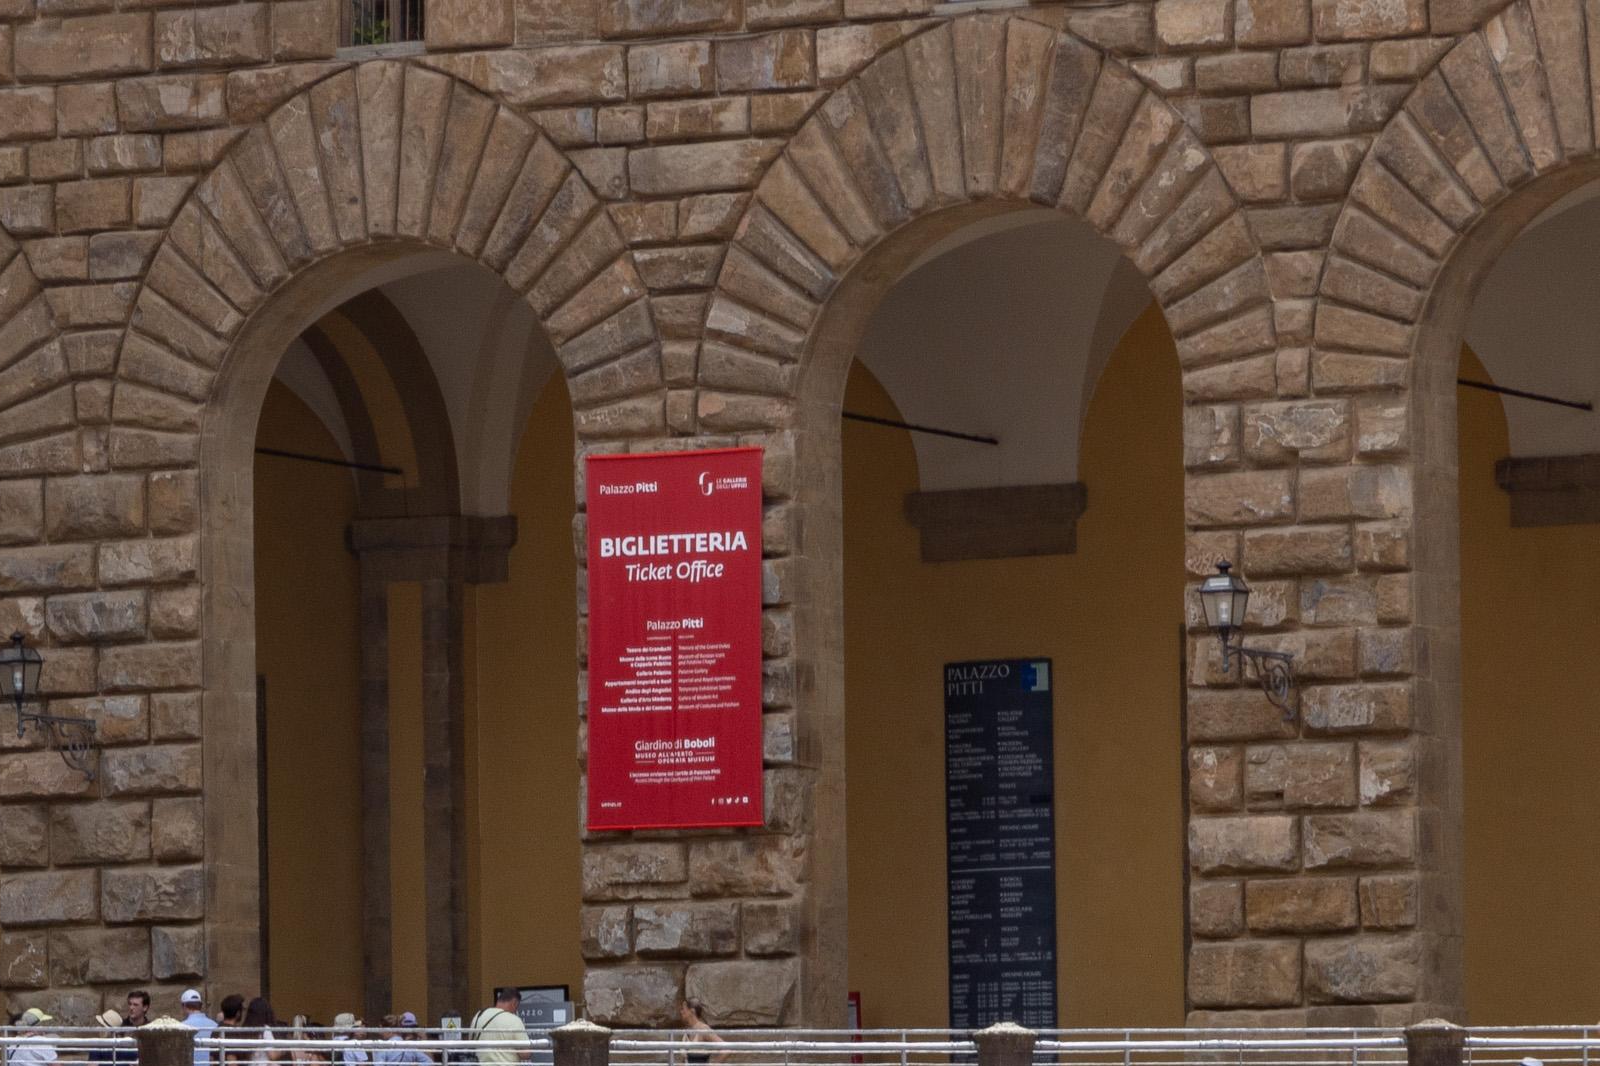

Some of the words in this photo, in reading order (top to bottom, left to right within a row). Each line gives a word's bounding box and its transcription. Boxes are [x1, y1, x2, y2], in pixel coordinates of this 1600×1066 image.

[600, 484, 634, 495] Palazzo
[636, 481, 658, 493] Pitti
[600, 531, 747, 558] BIGLIETTERIA
[625, 563, 672, 582] Ticket
[676, 560, 724, 583] Office
[646, 620, 681, 631] Palazzo
[682, 618, 703, 628] Pitti
[948, 664, 1010, 681] PALAZZO
[949, 681, 984, 696] PITTI
[635, 739, 673, 751] Giardino
[675, 739, 682, 749] di
[684, 736, 715, 748] Boboli
